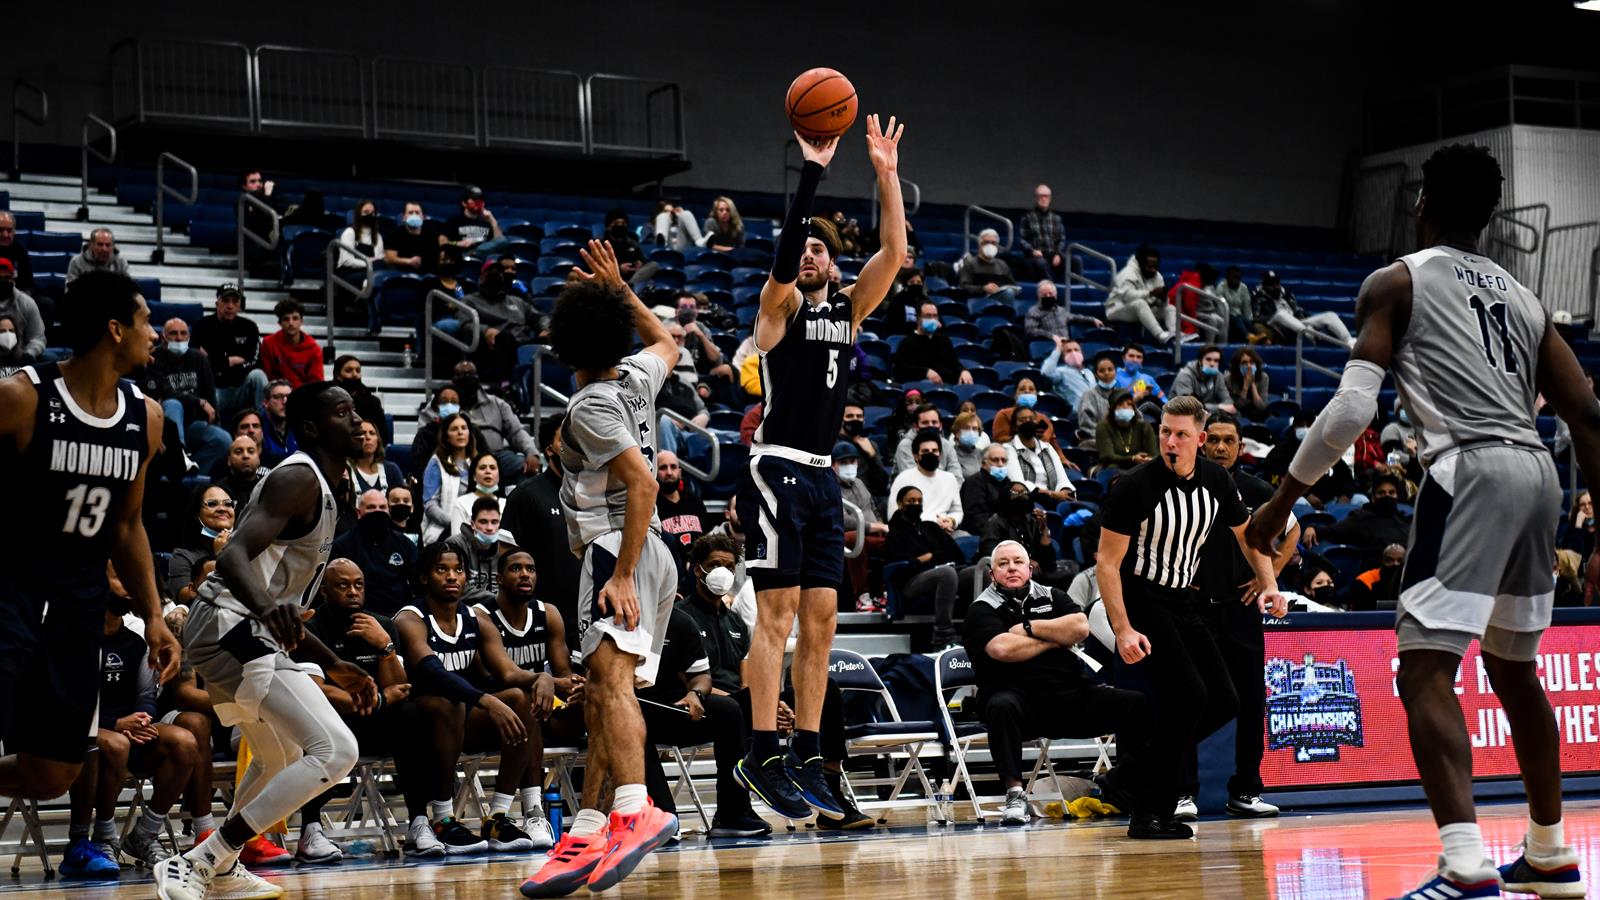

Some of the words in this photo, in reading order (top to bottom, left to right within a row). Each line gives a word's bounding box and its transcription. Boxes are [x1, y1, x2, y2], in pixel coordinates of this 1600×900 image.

[1468, 294, 1518, 374] 11
[826, 349, 840, 389] 5
[50, 439, 139, 481] MONMOUTH
[62, 483, 112, 538] 13
[837, 660, 865, 673] Peter's
